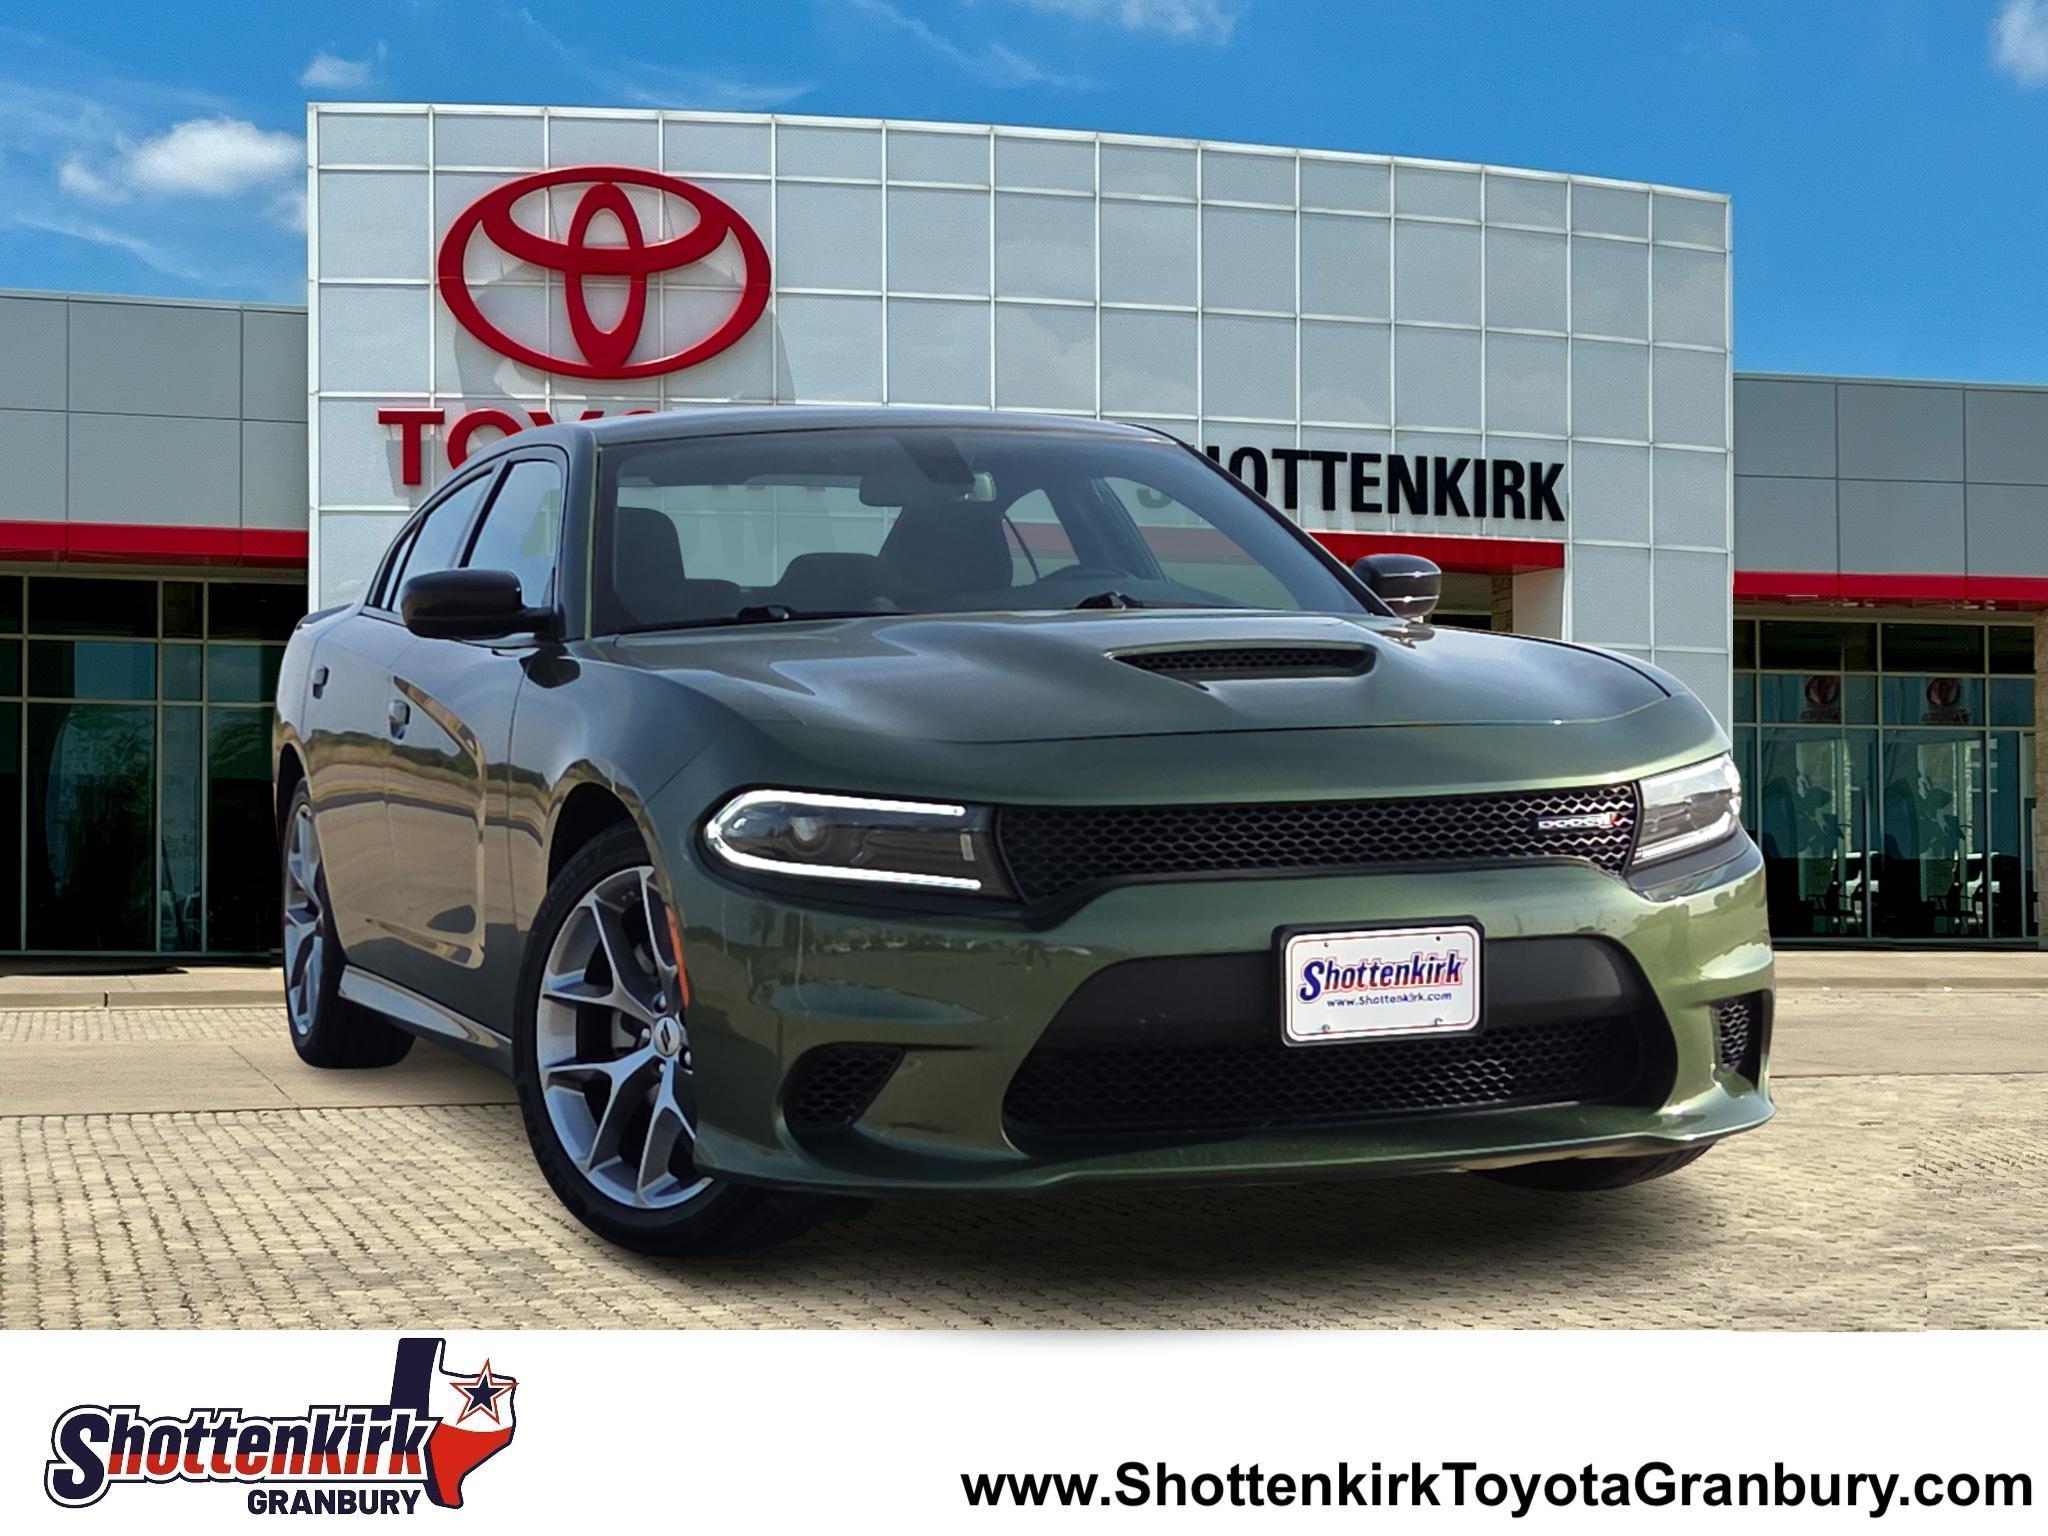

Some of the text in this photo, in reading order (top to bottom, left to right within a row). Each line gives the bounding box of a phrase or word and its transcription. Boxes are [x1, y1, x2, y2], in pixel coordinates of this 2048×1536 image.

[1137, 444, 1566, 522] OTTENKIRK
[1298, 951, 1465, 1002] Shottenkirk
[1326, 992, 1452, 1008] www.Shottenkirk.com
